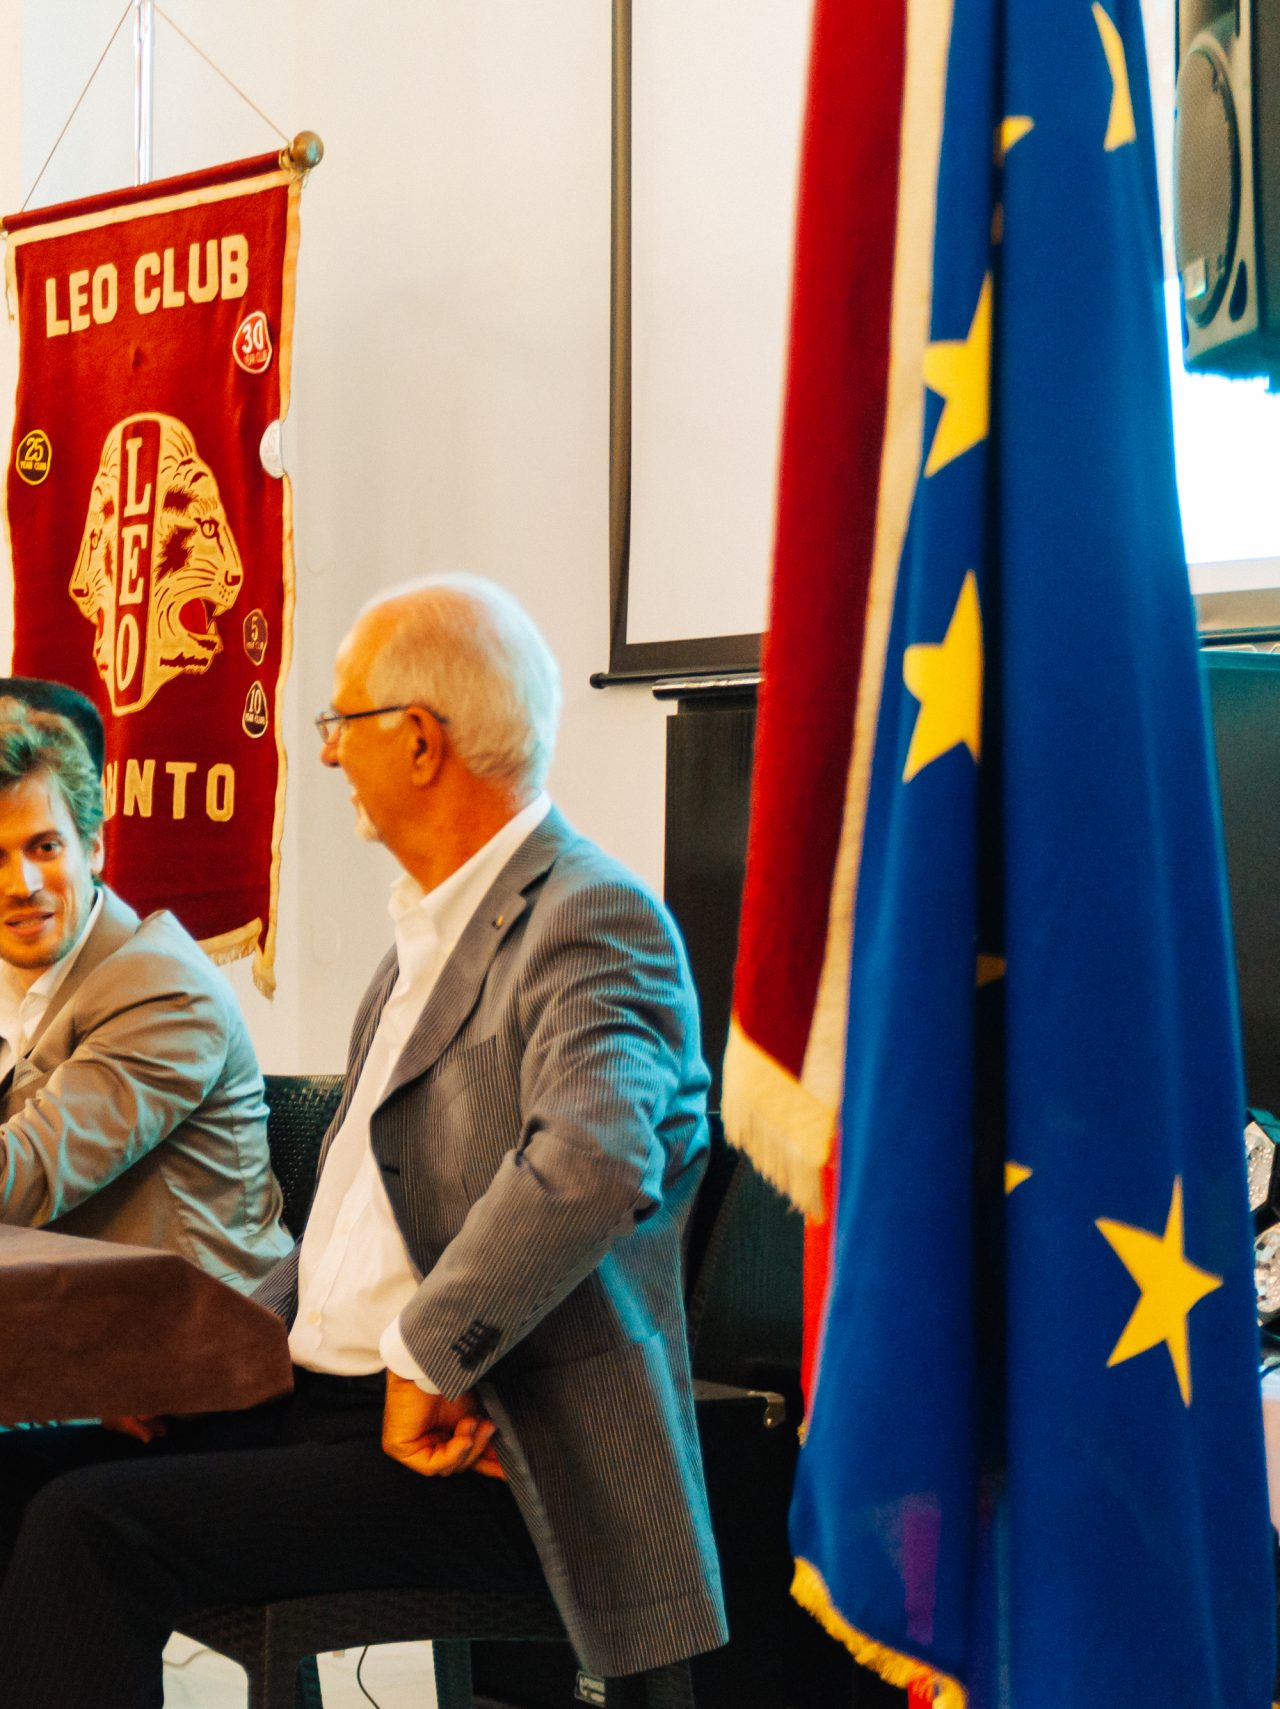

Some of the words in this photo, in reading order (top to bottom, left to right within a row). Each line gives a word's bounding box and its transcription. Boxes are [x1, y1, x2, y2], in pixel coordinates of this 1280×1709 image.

[45, 262, 118, 339] LEO
[134, 234, 249, 315] CLUB
[241, 319, 264, 354] 30
[24, 437, 45, 461] 25
[117, 436, 152, 692] LEO
[248, 688, 262, 714] 10
